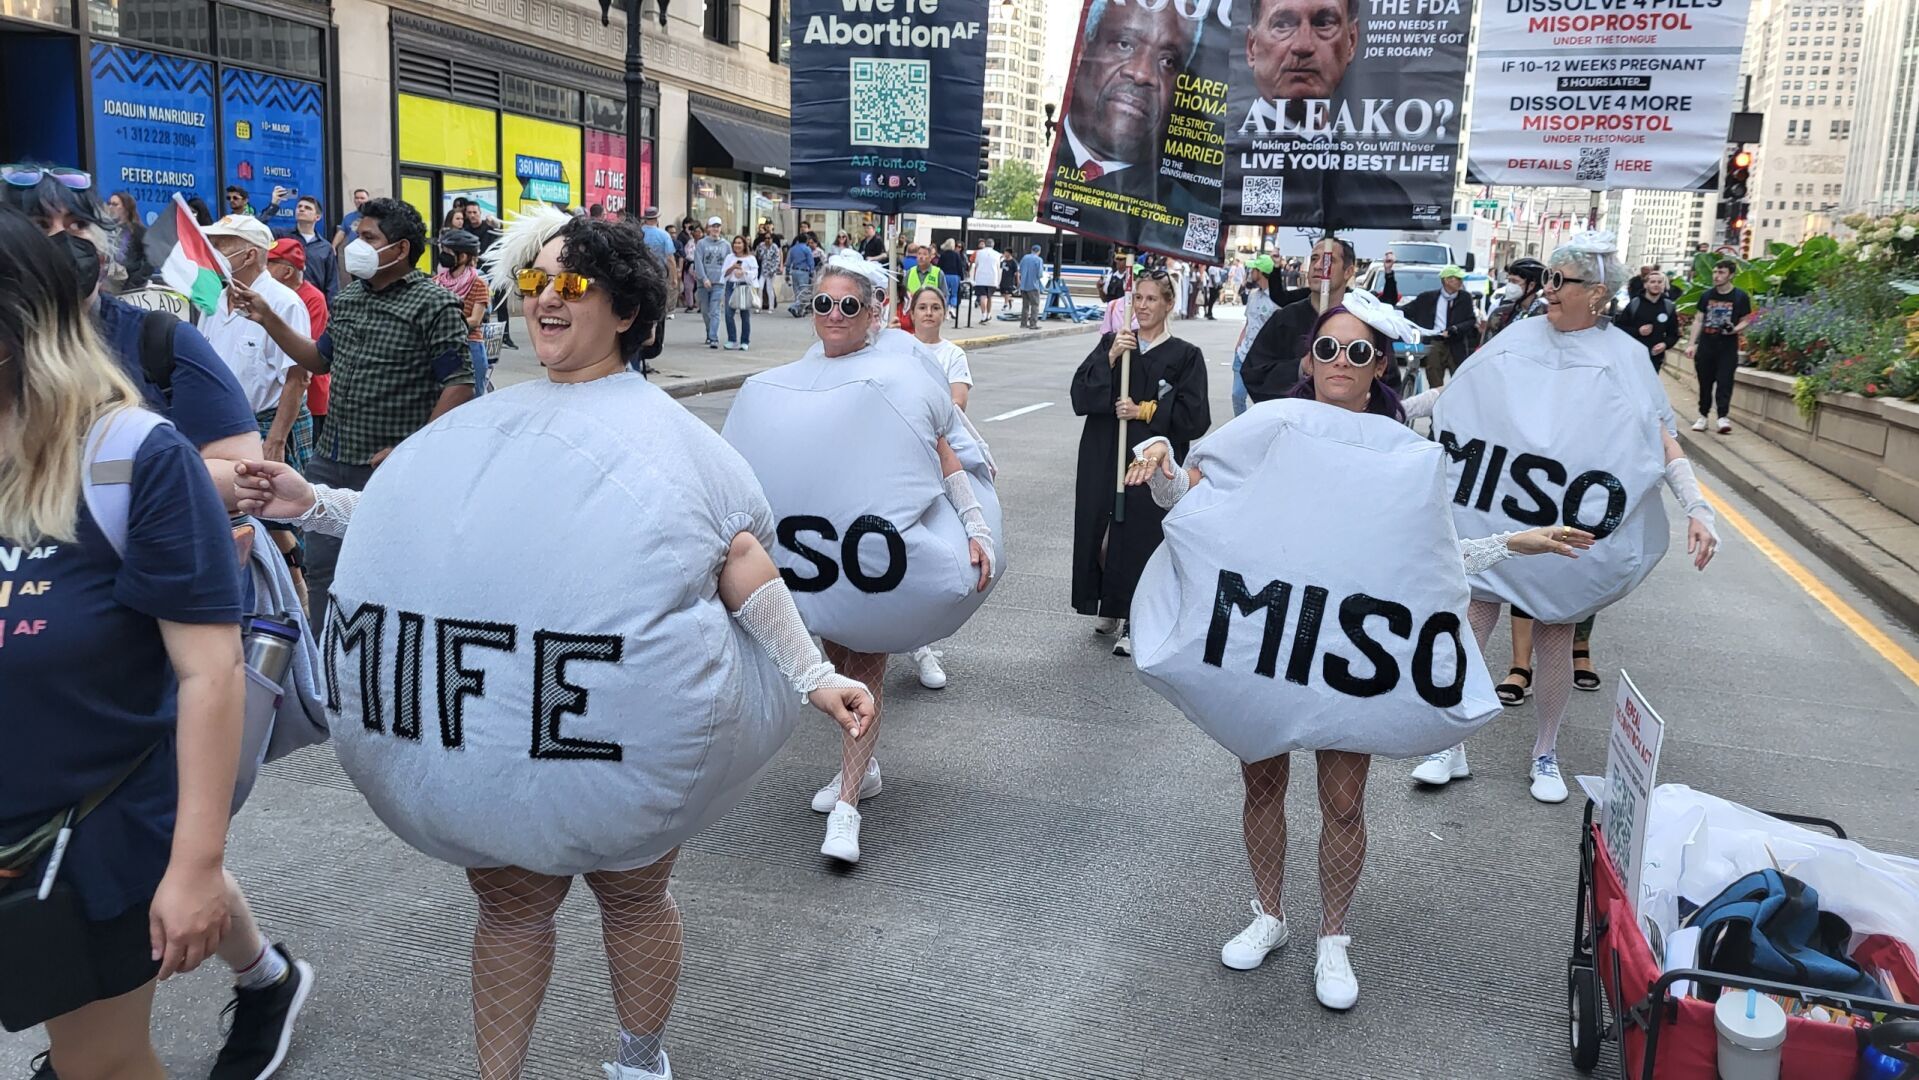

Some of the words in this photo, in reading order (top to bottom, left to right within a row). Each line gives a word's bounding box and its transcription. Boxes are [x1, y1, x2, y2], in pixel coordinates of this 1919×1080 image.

[1369, 0, 1410, 15] THE
[1416, 0, 1460, 15] FDA
[803, 15, 951, 48] Abortion
[1367, 20, 1396, 31] WHO
[1398, 20, 1435, 31] NEEDS
[1437, 20, 1448, 31] IT
[1528, 13, 1692, 33] MISOPROSTOL
[1366, 33, 1401, 44] WHEN
[1403, 33, 1437, 44] WE'VE
[1439, 33, 1464, 44] GOT
[1553, 35, 1592, 45] UNDER
[1595, 35, 1615, 44] THE
[1615, 34, 1657, 44] TONGUE
[1364, 46, 1384, 59] JOE
[1386, 46, 1434, 57] ROGAN?
[1501, 61, 1516, 73] IF
[1564, 59, 1617, 72] WEEKS
[1619, 58, 1706, 72] PREGNANT
[1561, 78, 1569, 88] 3
[1570, 77, 1608, 88] HOURS
[1509, 95, 1611, 112] DISSOLVE
[1614, 95, 1628, 111] 4
[1630, 95, 1692, 111] MORE
[104, 99, 147, 119] JOAQUIN
[148, 106, 206, 127] MANRIQUEZ
[1170, 113, 1185, 126] THE
[1185, 117, 1216, 132] STRICT
[1522, 114, 1673, 131] MISOPROSTOL
[115, 126, 128, 139] +1
[131, 126, 150, 143] 312
[152, 129, 170, 145] 228
[172, 132, 196, 148] 3094
[1168, 124, 1225, 146] DESTRUCTION
[1543, 134, 1582, 144] UNDER
[1604, 134, 1646, 144] TONGUE
[1164, 139, 1225, 165] MARRIED
[1252, 140, 1291, 152] Making
[1292, 141, 1339, 151] Decisions
[1340, 141, 1354, 151] So
[1356, 141, 1378, 151] You
[1379, 141, 1400, 151] Will
[1402, 141, 1436, 152] Never
[518, 159, 533, 174] 360
[534, 161, 559, 178] NORTH
[850, 155, 927, 172] AAFront.org
[1161, 158, 1171, 167] TO
[1171, 160, 1183, 170] THE
[1240, 152, 1285, 169] LIVE
[1289, 153, 1340, 170] YOUR
[1343, 154, 1396, 171] BEST
[1398, 155, 1450, 172] LIFE!
[1507, 158, 1573, 170] DETAILS
[1614, 159, 1653, 172] HERE
[121, 166, 153, 184] PETER
[155, 170, 195, 187] CARUSO
[270, 167, 291, 177] HOTELS
[594, 169, 605, 188] AT
[607, 169, 624, 191] THE
[1057, 165, 1087, 183] PLUS
[532, 182, 568, 202] MICHIGAN
[1068, 183, 1092, 194] COMING
[1092, 188, 1105, 196] FOR
[1105, 192, 1119, 200] OUR
[1119, 195, 1139, 205] BIRTH
[1139, 200, 1168, 213] CONTROL
[1053, 188, 1071, 199] BUT
[1071, 191, 1103, 207] WHERE
[1103, 199, 1126, 213] WILL
[1127, 204, 1141, 216] HE
[1141, 209, 1172, 225] STORE
[1171, 216, 1185, 227] IT?
[1438, 429, 1628, 541] MISO
[27, 545, 58, 560] AF
[18, 581, 52, 595] AF
[13, 620, 47, 634] AF
[1203, 568, 1467, 708] MISO
[322, 592, 626, 762] MIFE
